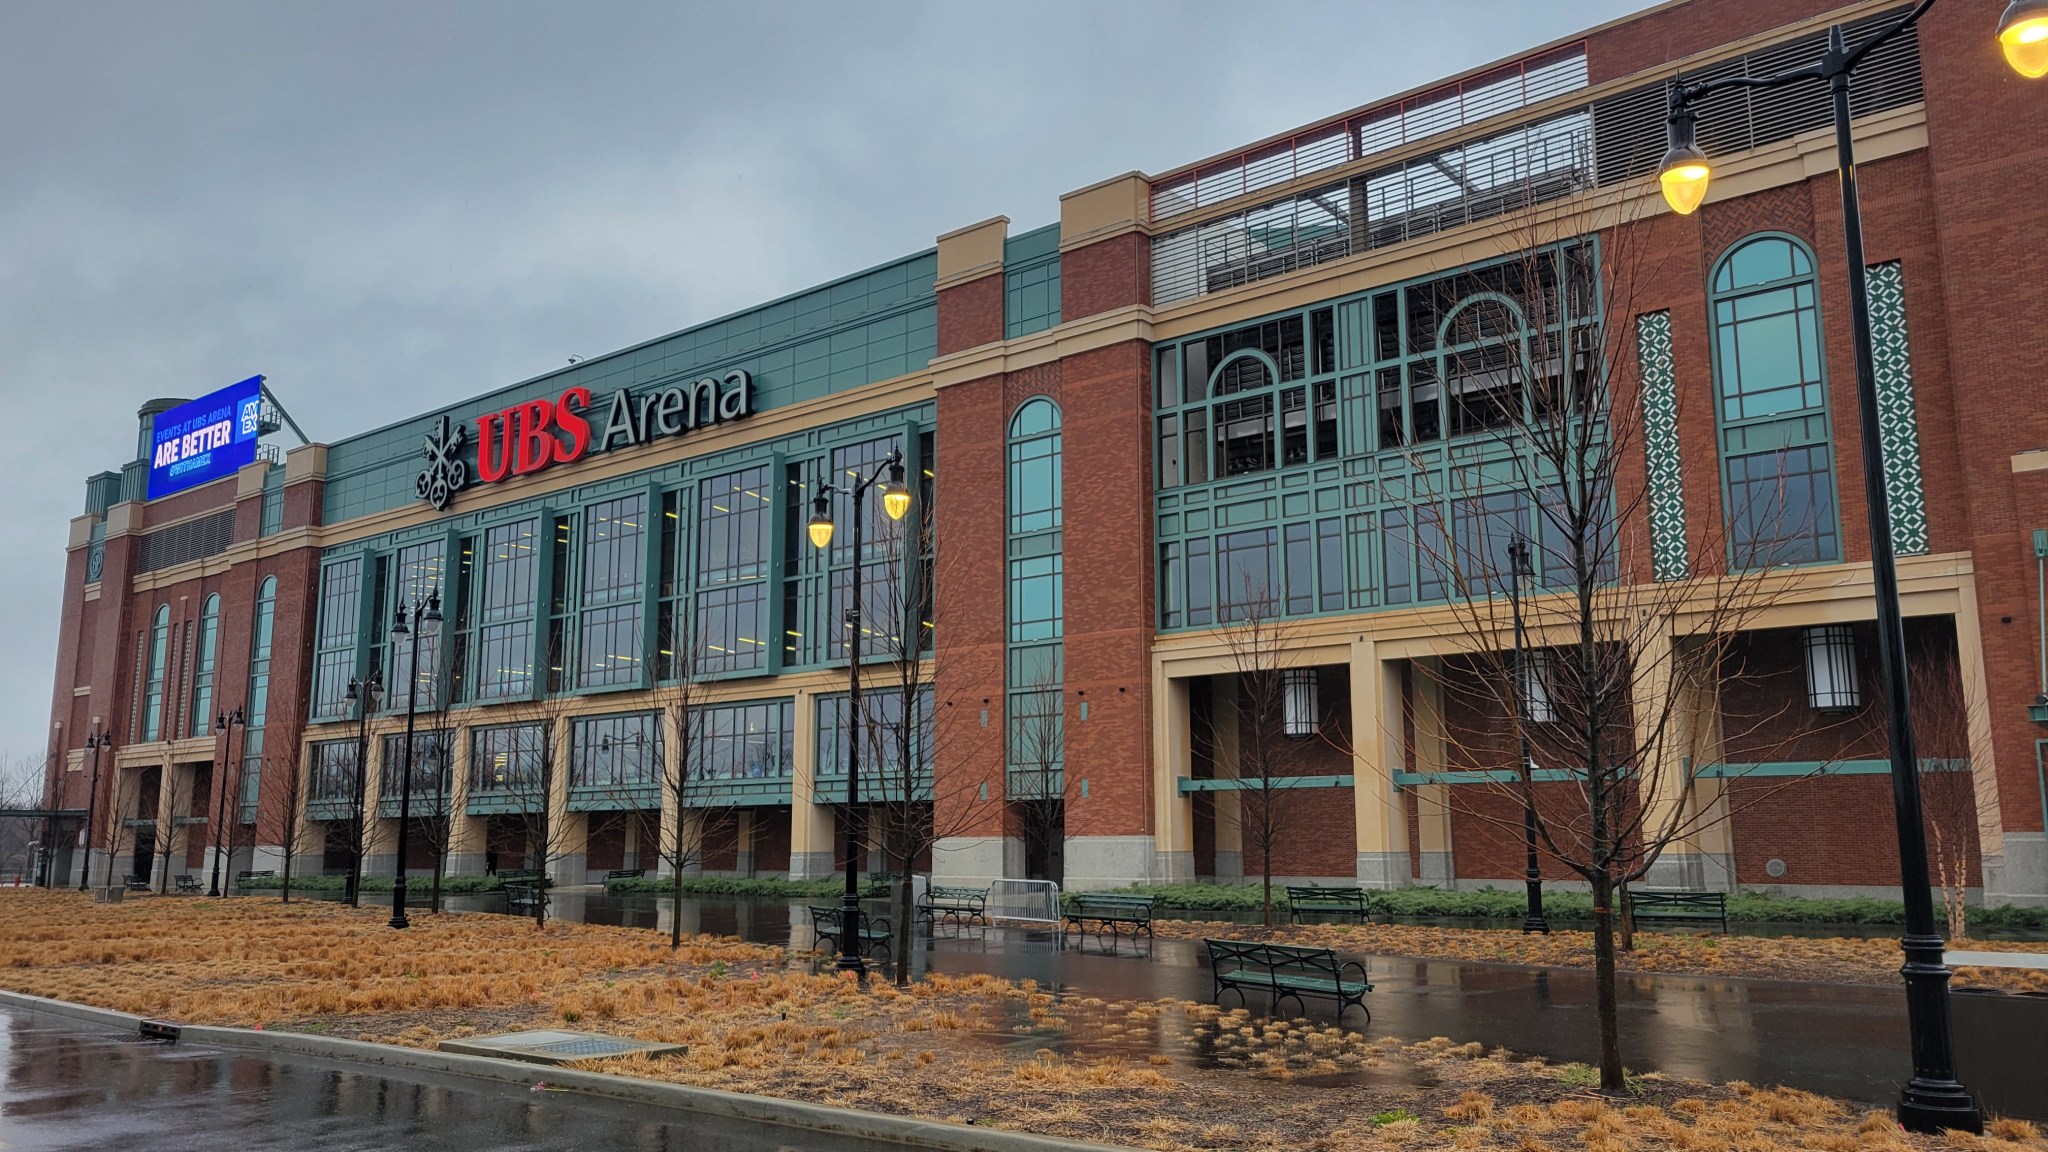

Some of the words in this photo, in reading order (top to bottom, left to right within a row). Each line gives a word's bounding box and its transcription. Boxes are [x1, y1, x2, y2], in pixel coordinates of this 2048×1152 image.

[153, 438, 180, 469] ARE
[181, 419, 232, 459] BETTER
[156, 424, 182, 443] EVENTS
[182, 420, 192, 433] AT
[192, 414, 207, 430] UBS
[207, 405, 232, 424] ARENA
[475, 386, 592, 483] UBS
[600, 368, 757, 452] Arena
